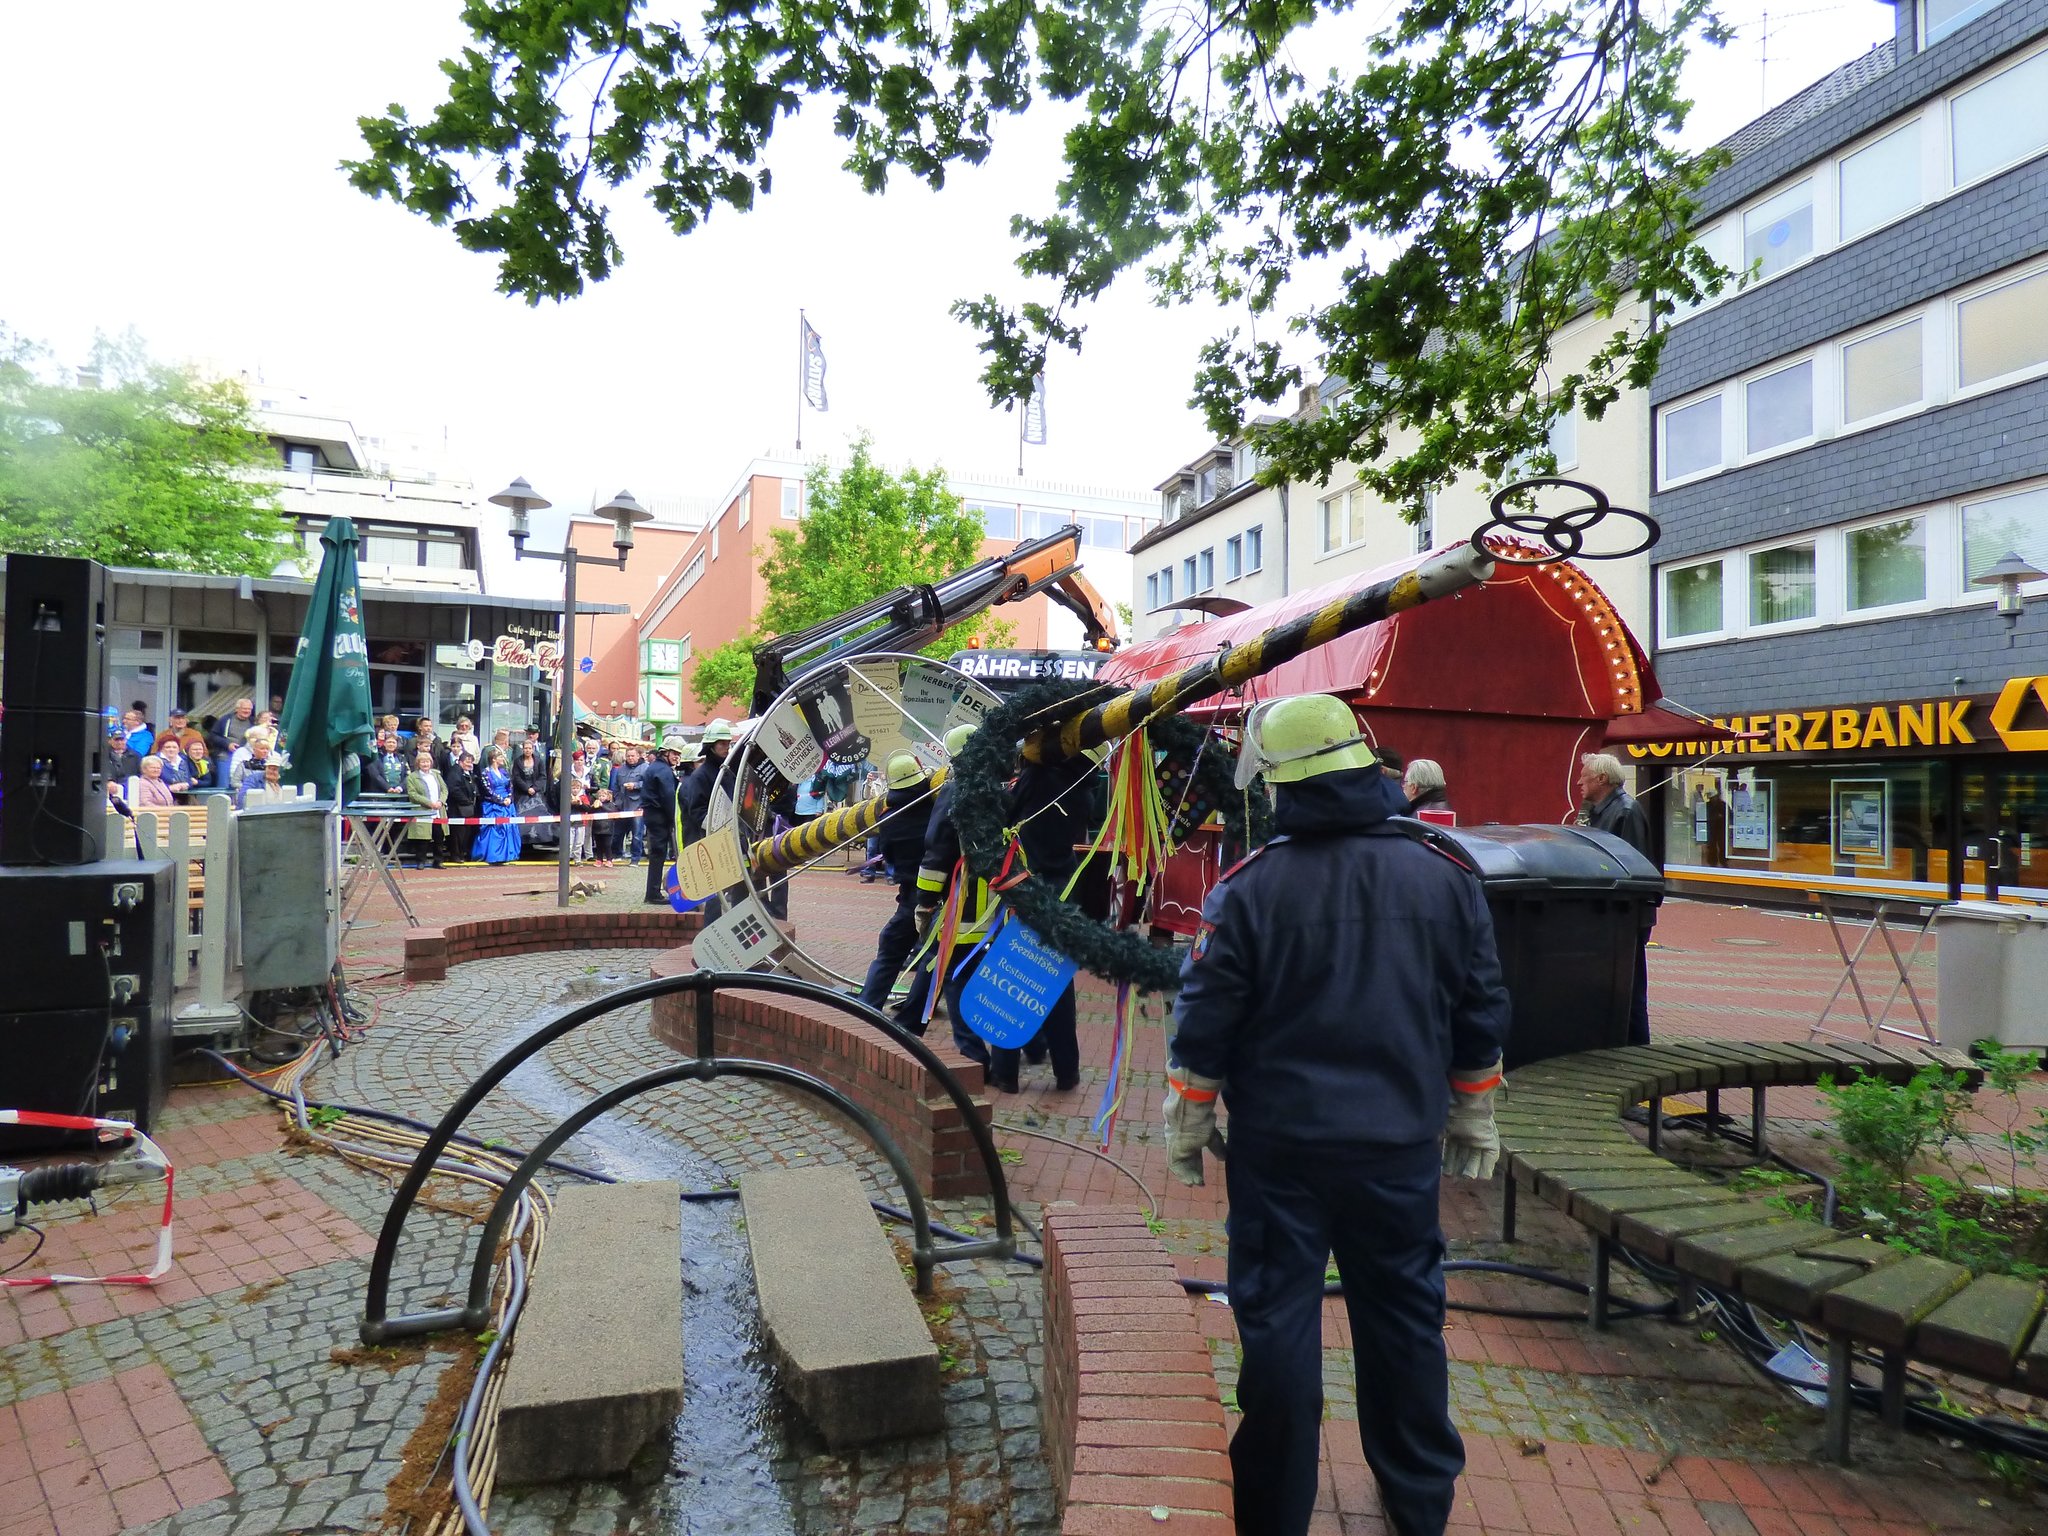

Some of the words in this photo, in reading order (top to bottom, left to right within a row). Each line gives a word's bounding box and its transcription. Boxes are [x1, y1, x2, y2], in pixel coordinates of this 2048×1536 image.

[530, 628, 542, 637] Bar
[960, 655, 1095, 679] BÄHR-ESSEN
[920, 689, 929, 697] Ihr
[921, 674, 954, 690] HERBER
[903, 695, 934, 704] Spezialist
[961, 694, 991, 714] DEV
[780, 733, 812, 769] LAURENTIUS
[788, 744, 815, 772] APOTHEKE
[1171, 810, 1191, 827] seele
[711, 925, 729, 950] KANZLEI
[729, 951, 744, 969] TERNA
[1009, 938, 1059, 977] Spezialitäten
[998, 957, 1047, 995] Restaurant
[979, 965, 1048, 1017] BACCHOS
[983, 1021, 995, 1033] 08
[995, 1029, 1007, 1041] 47
